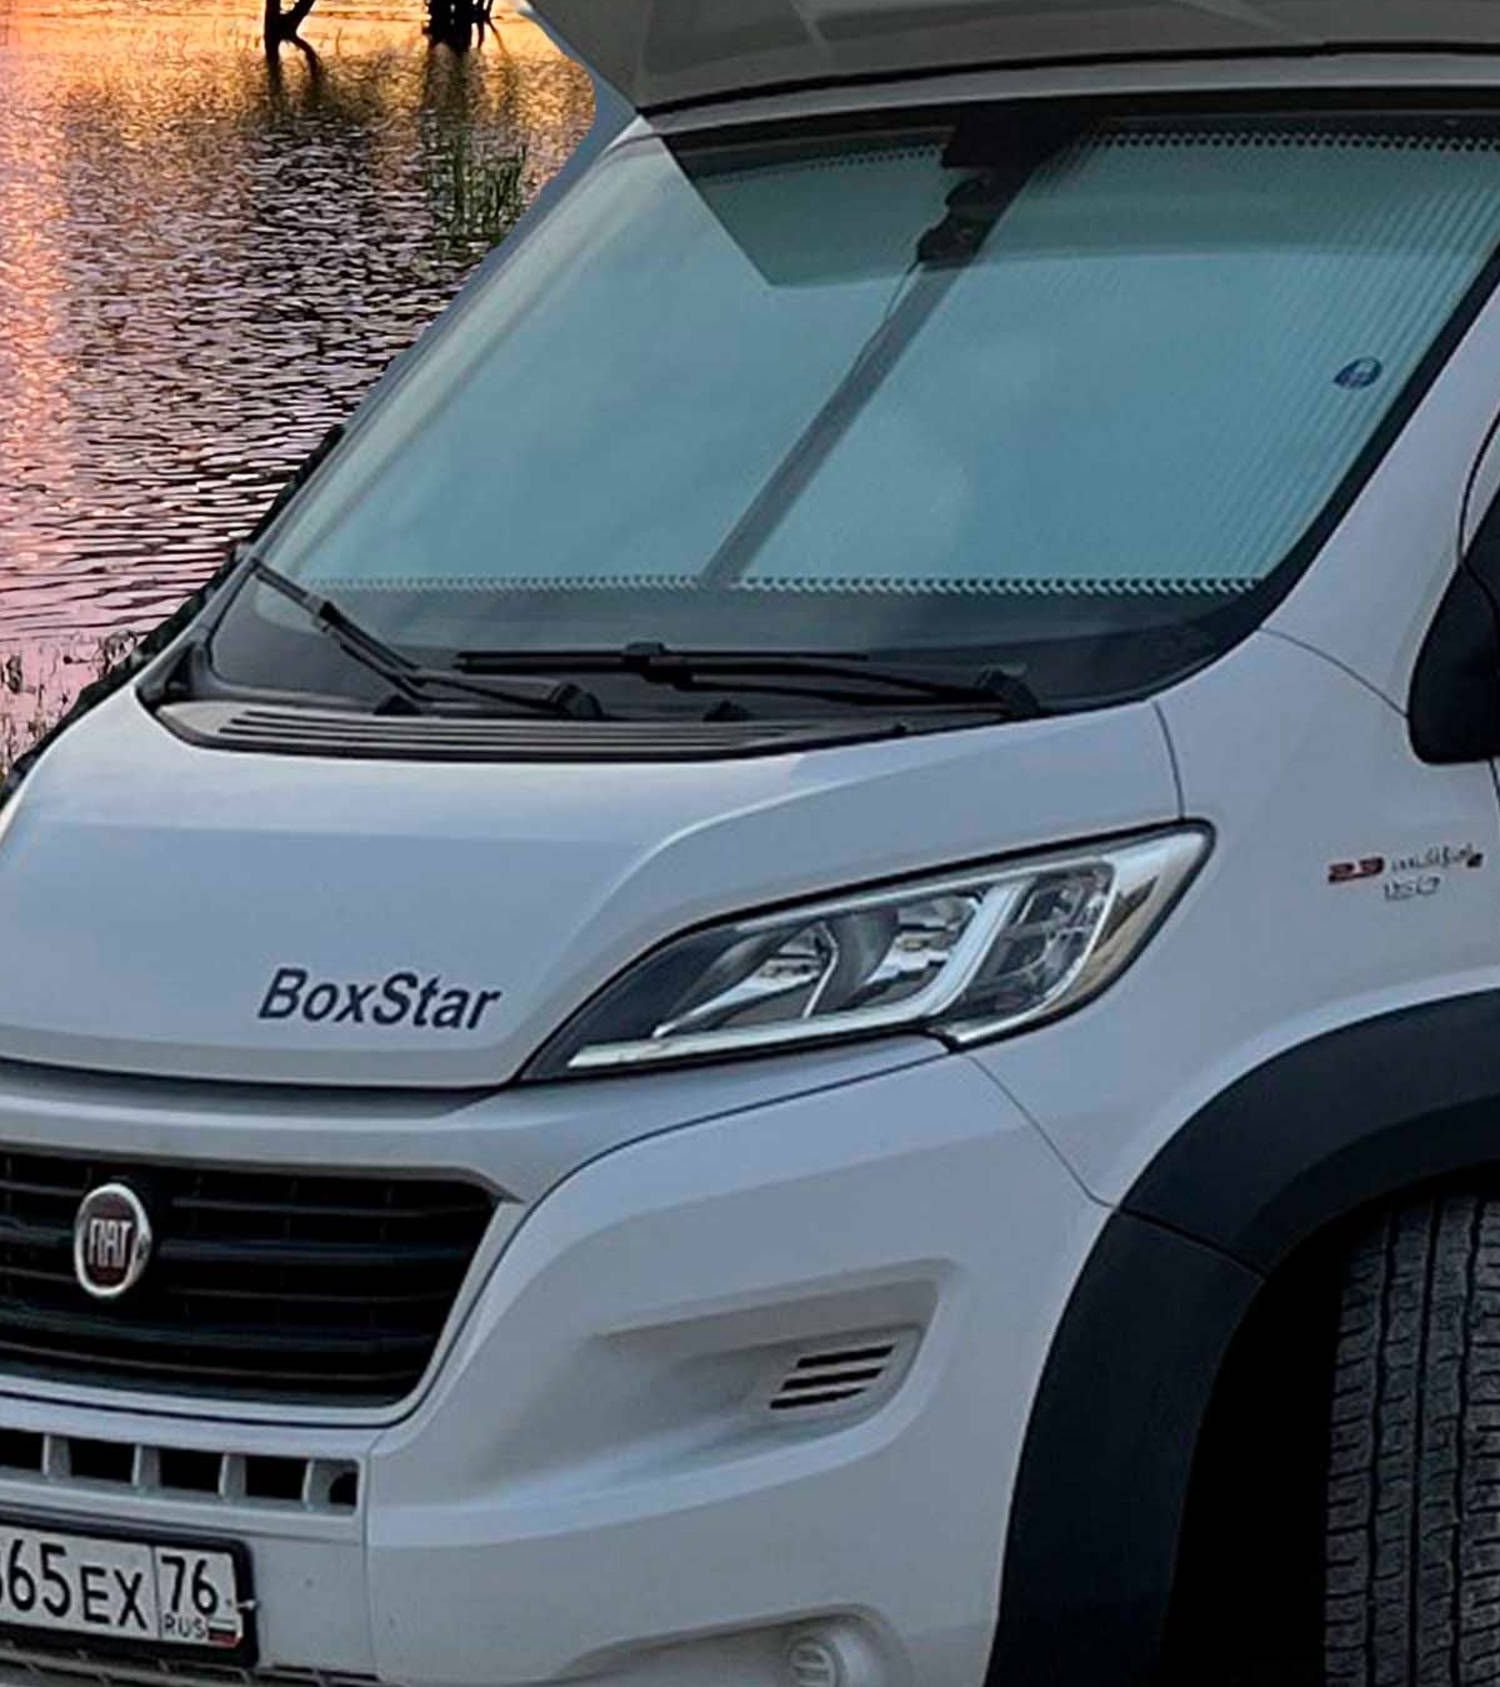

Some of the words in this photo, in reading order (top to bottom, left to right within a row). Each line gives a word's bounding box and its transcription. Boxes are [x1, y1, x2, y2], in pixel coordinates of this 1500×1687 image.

[256, 967, 502, 1031] BoxStar
[160, 1554, 219, 1616] 76
[163, 1612, 207, 1639] RUS
